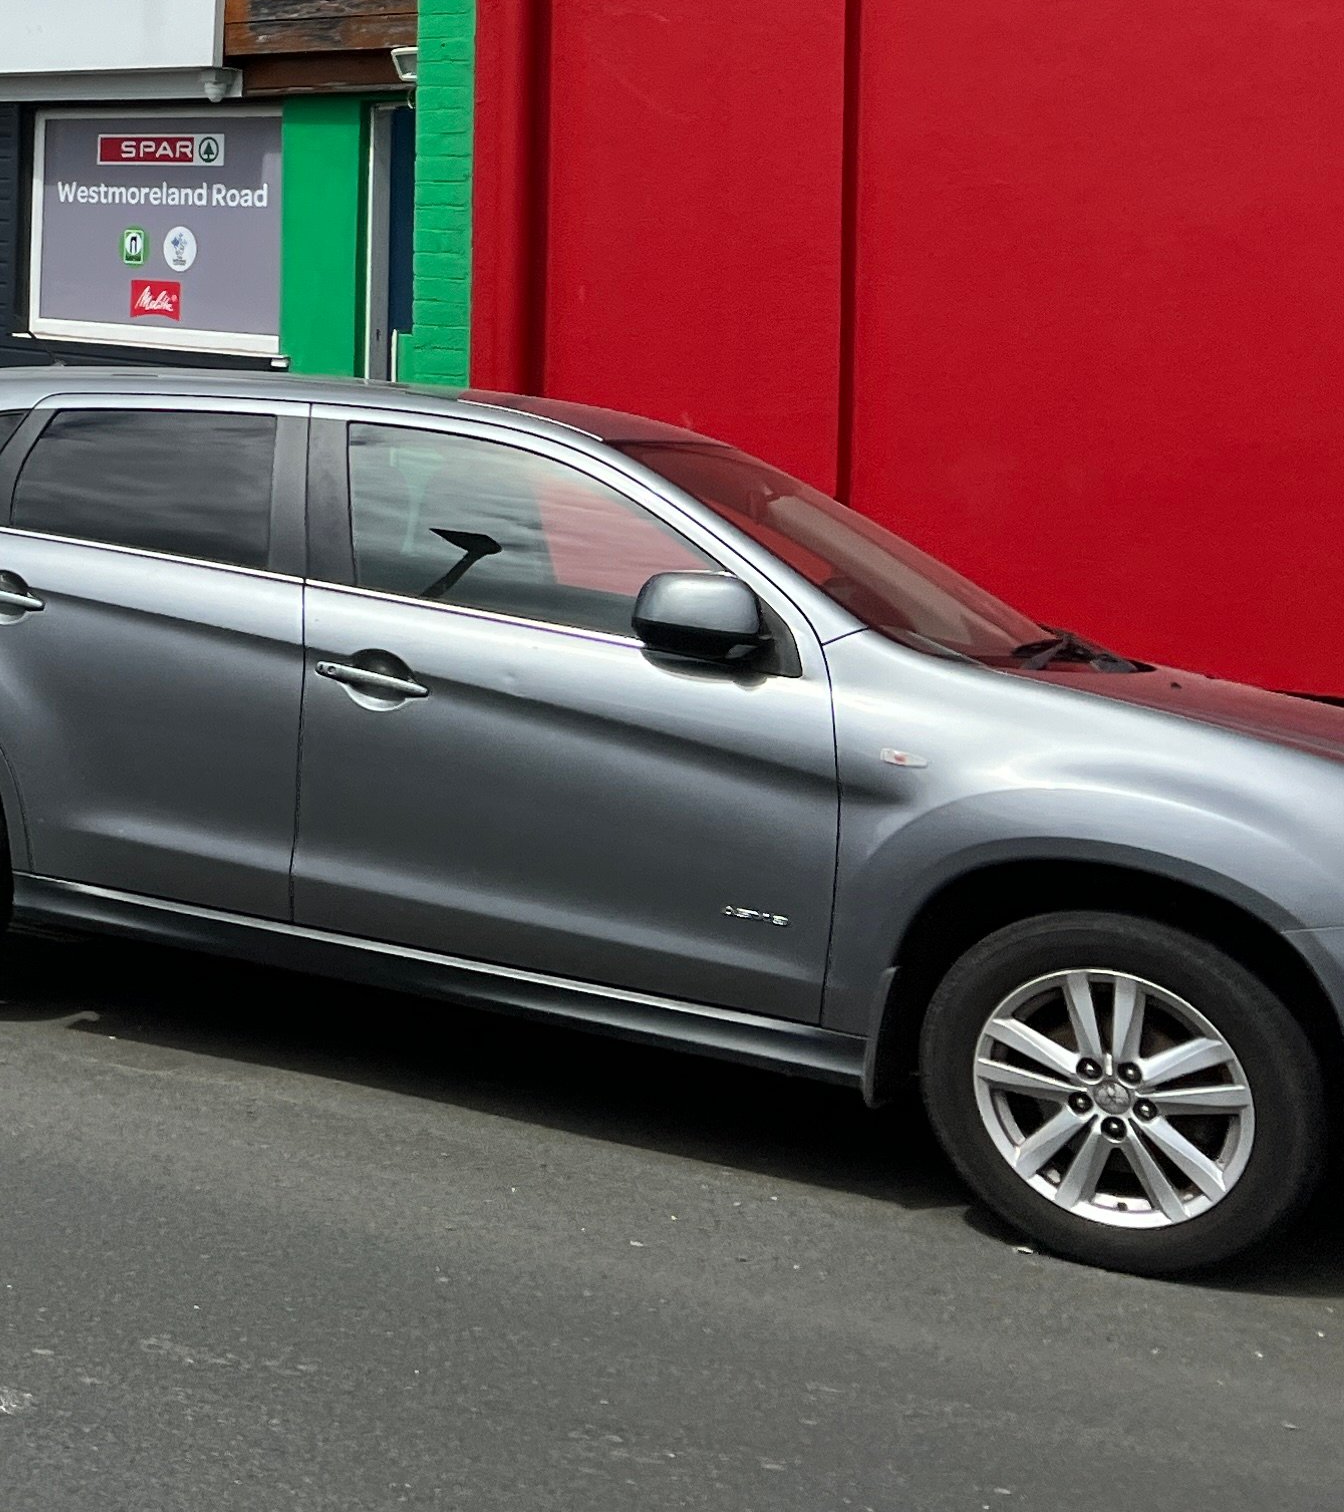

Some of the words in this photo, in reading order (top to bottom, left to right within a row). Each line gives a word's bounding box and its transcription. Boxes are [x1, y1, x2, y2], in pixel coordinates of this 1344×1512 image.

[121, 140, 193, 158] SPAR
[57, 181, 208, 206] Westmoreland
[212, 182, 269, 207] Road
